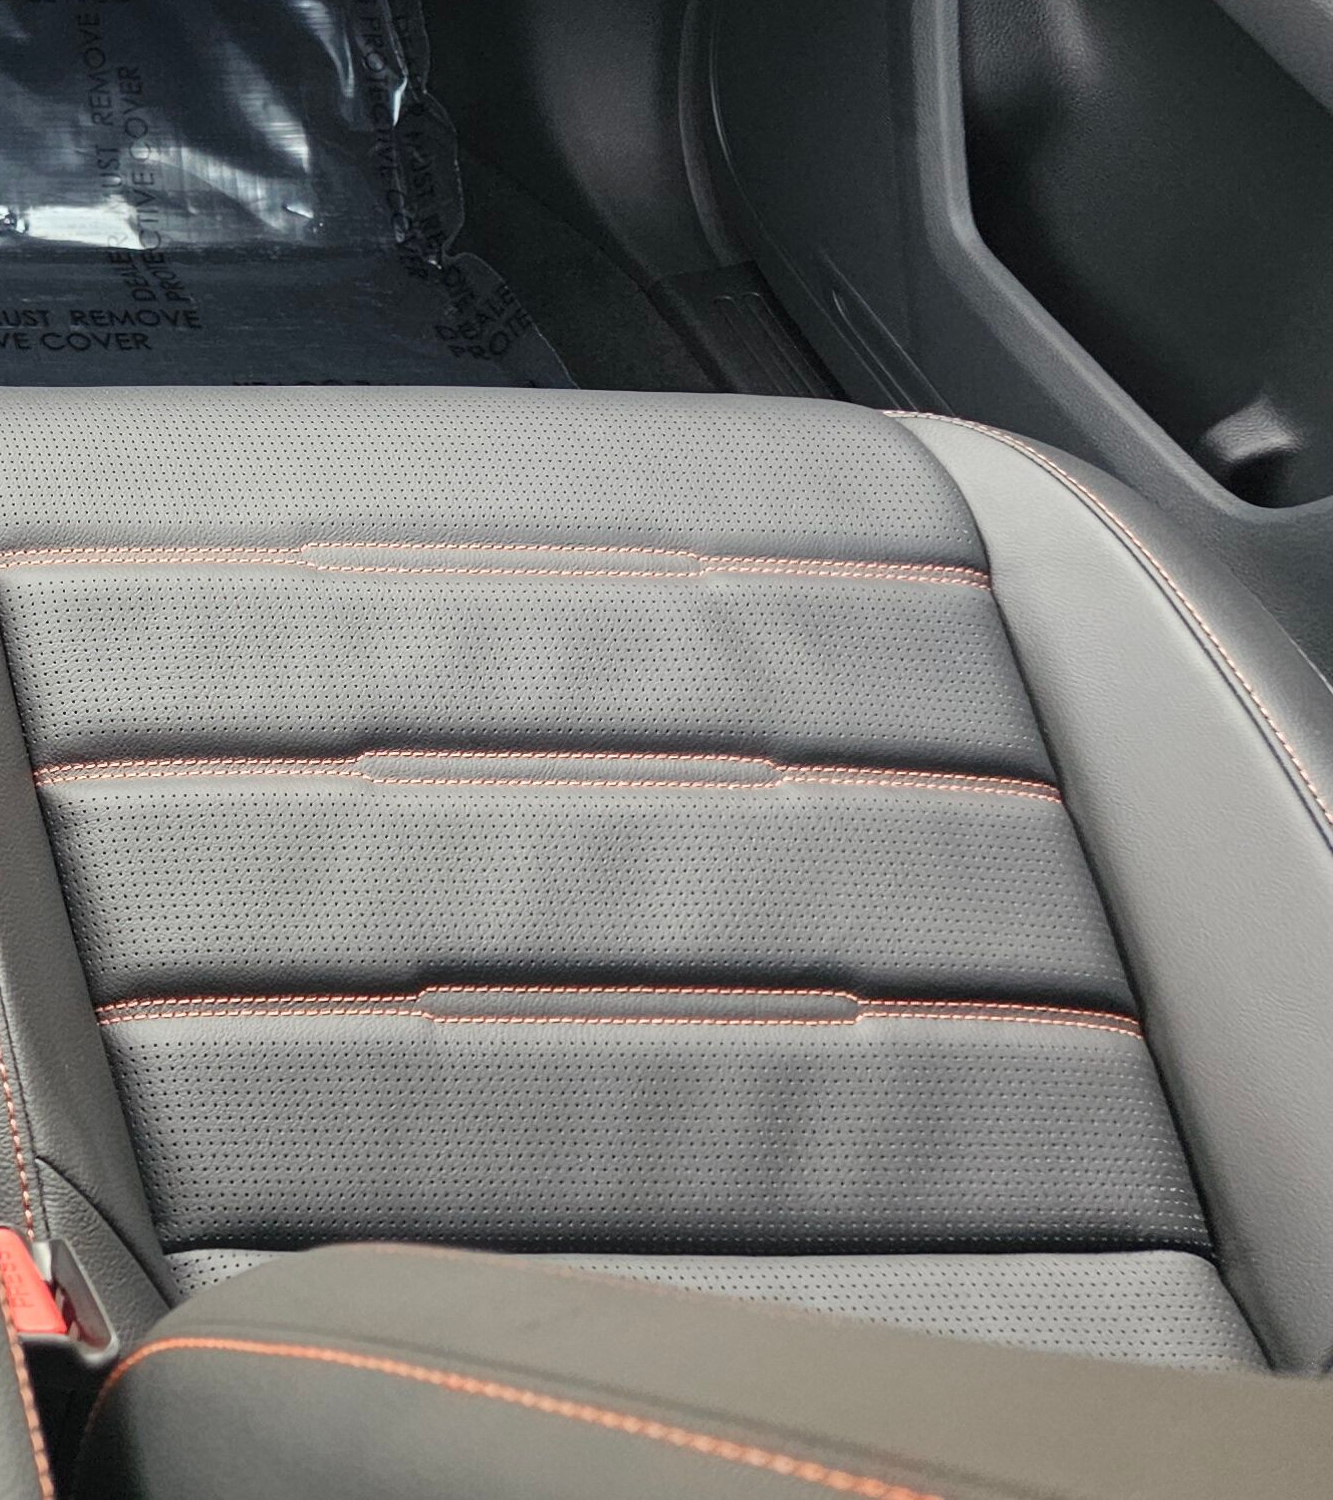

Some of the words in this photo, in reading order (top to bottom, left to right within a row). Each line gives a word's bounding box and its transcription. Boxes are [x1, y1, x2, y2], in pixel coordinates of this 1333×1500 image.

[76, 12, 113, 127] REMOVE
[118, 65, 150, 161] COVER
[39, 330, 154, 352] COVER
[68, 308, 202, 330] REMOVE
